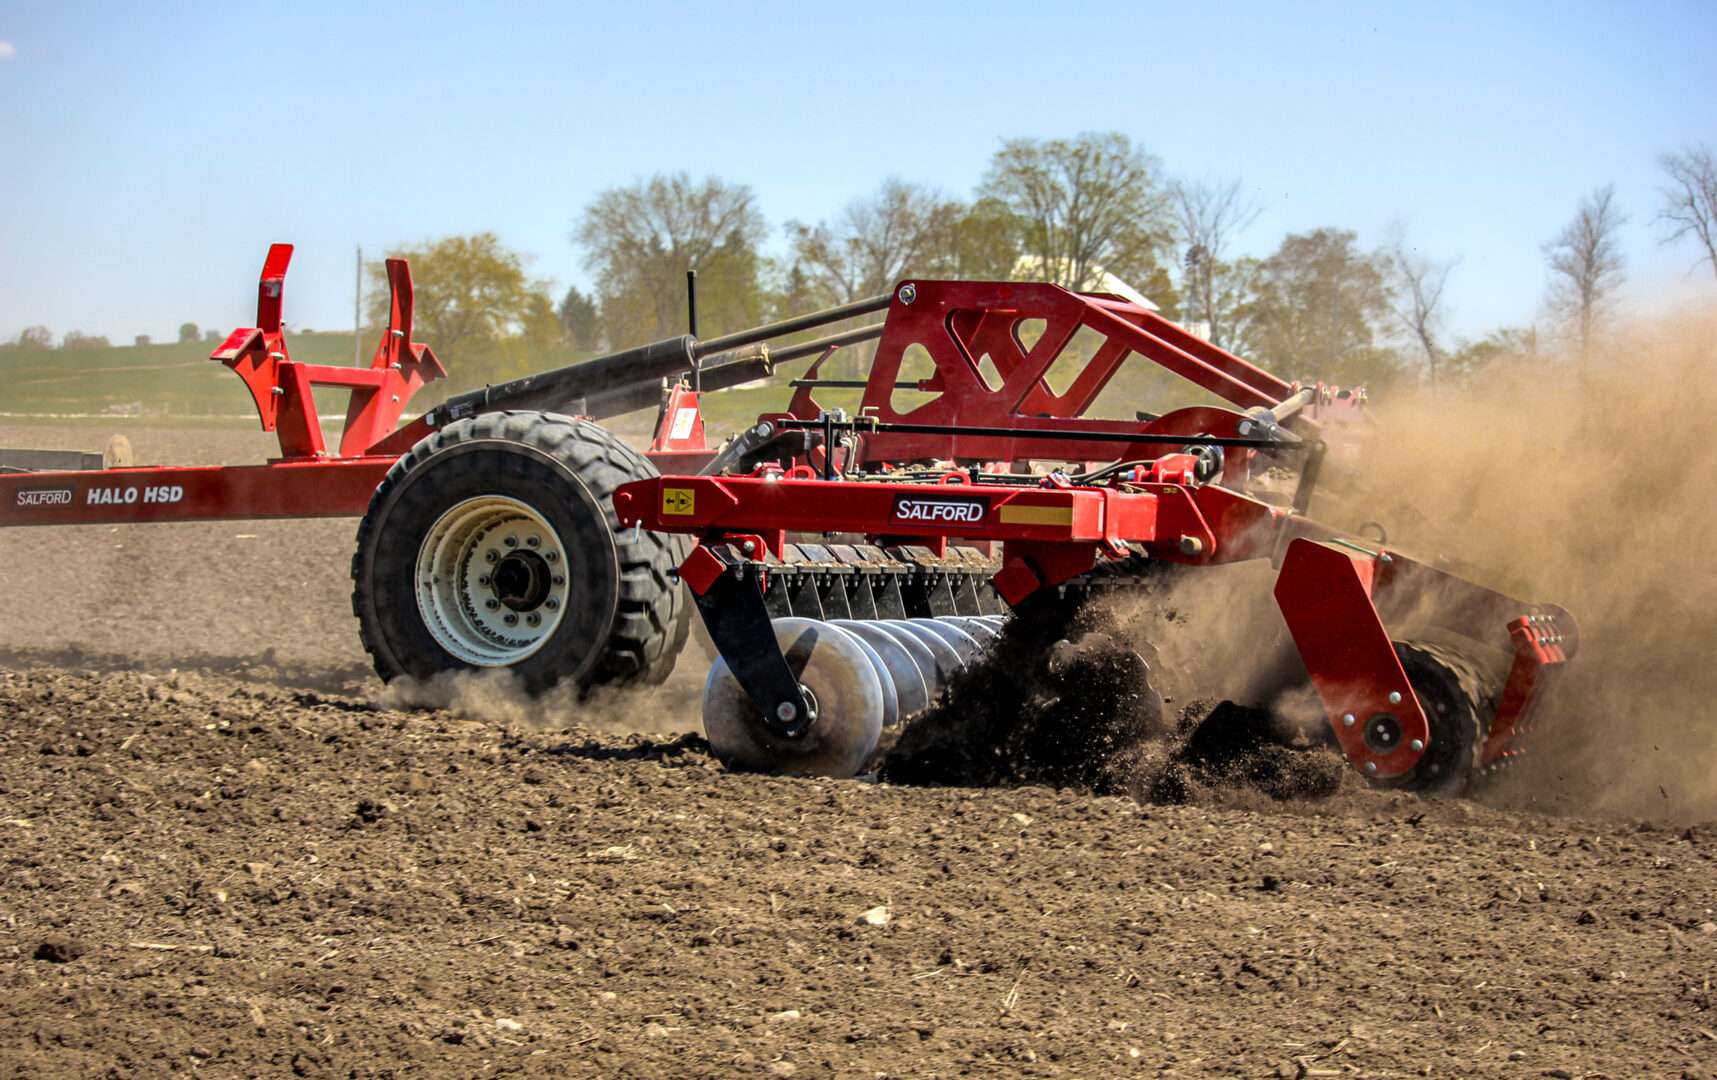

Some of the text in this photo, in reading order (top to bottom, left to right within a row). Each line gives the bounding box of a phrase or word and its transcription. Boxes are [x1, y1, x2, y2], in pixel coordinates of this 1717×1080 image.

[17, 489, 72, 506] SALFORD
[86, 486, 183, 505] HALO HSD
[896, 500, 983, 522] SALFORD
